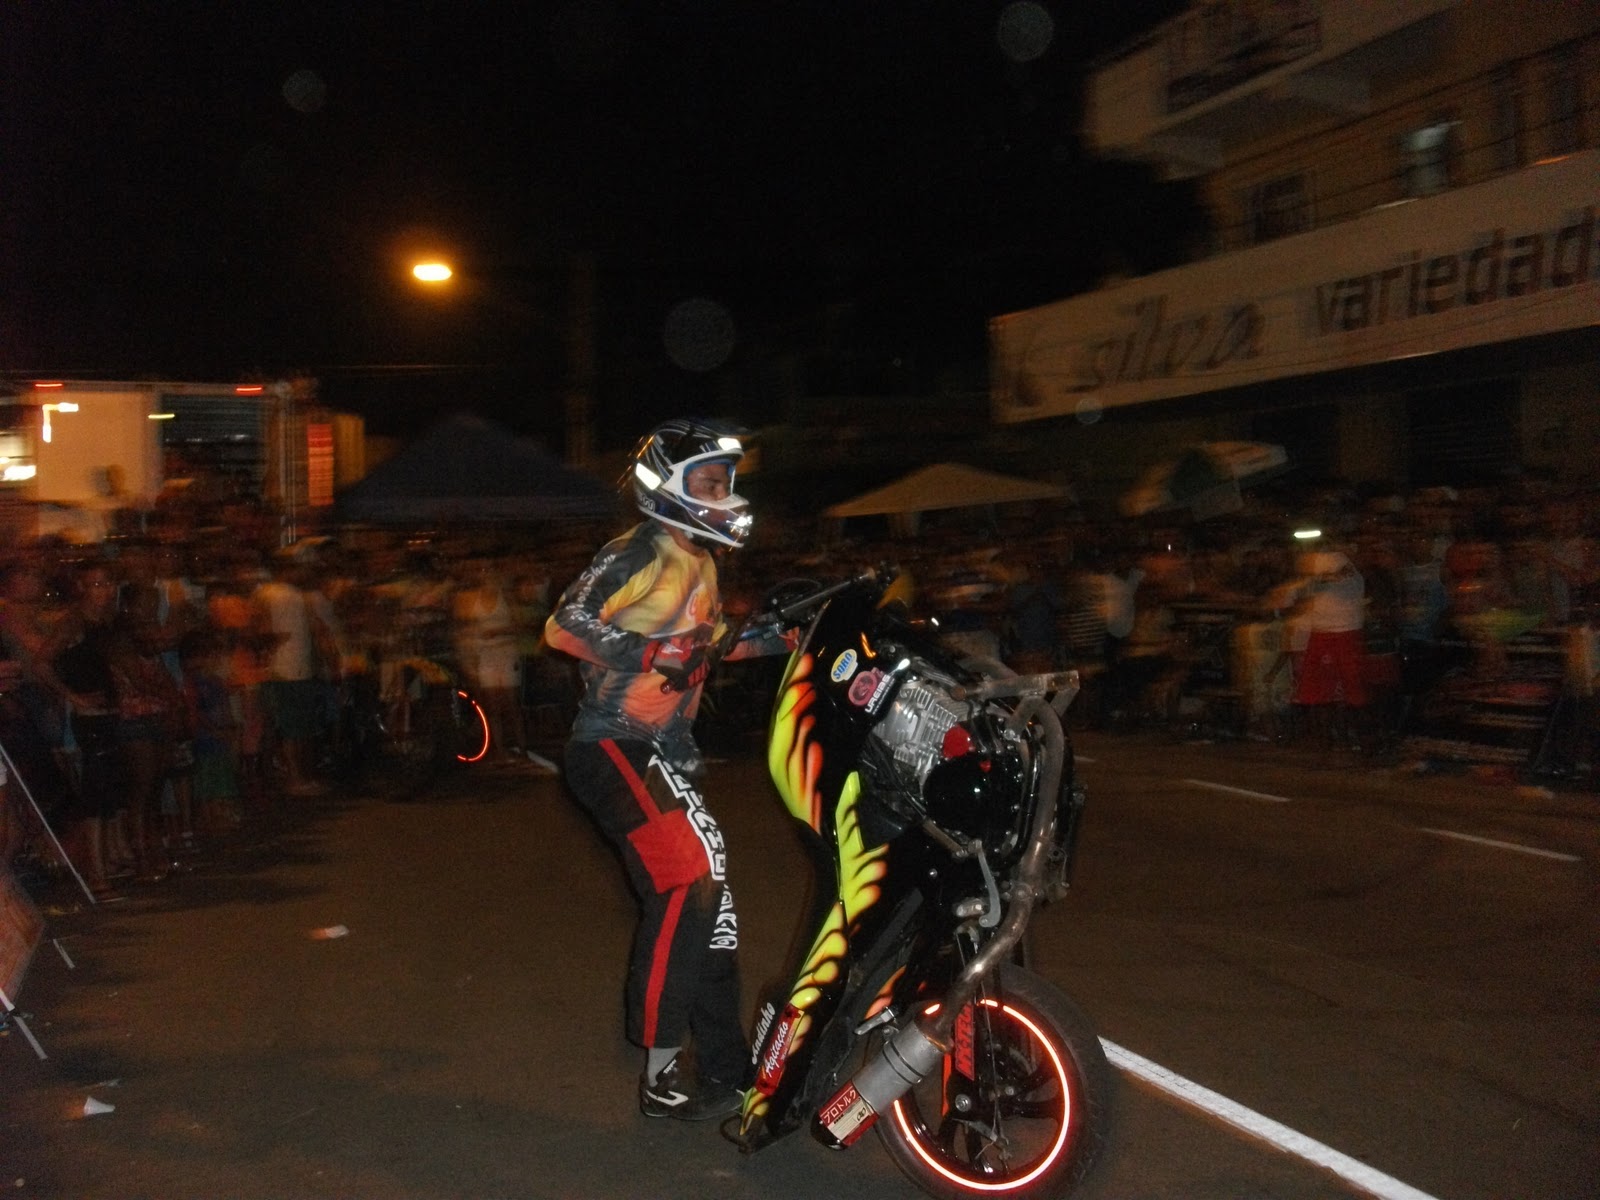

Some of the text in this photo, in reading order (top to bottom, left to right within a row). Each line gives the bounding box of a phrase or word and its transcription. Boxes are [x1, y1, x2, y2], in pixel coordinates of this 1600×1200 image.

[1315, 204, 1600, 333] variedad
[764, 1021, 789, 1078] Agitação
[823, 1089, 858, 1124] プロトルク
